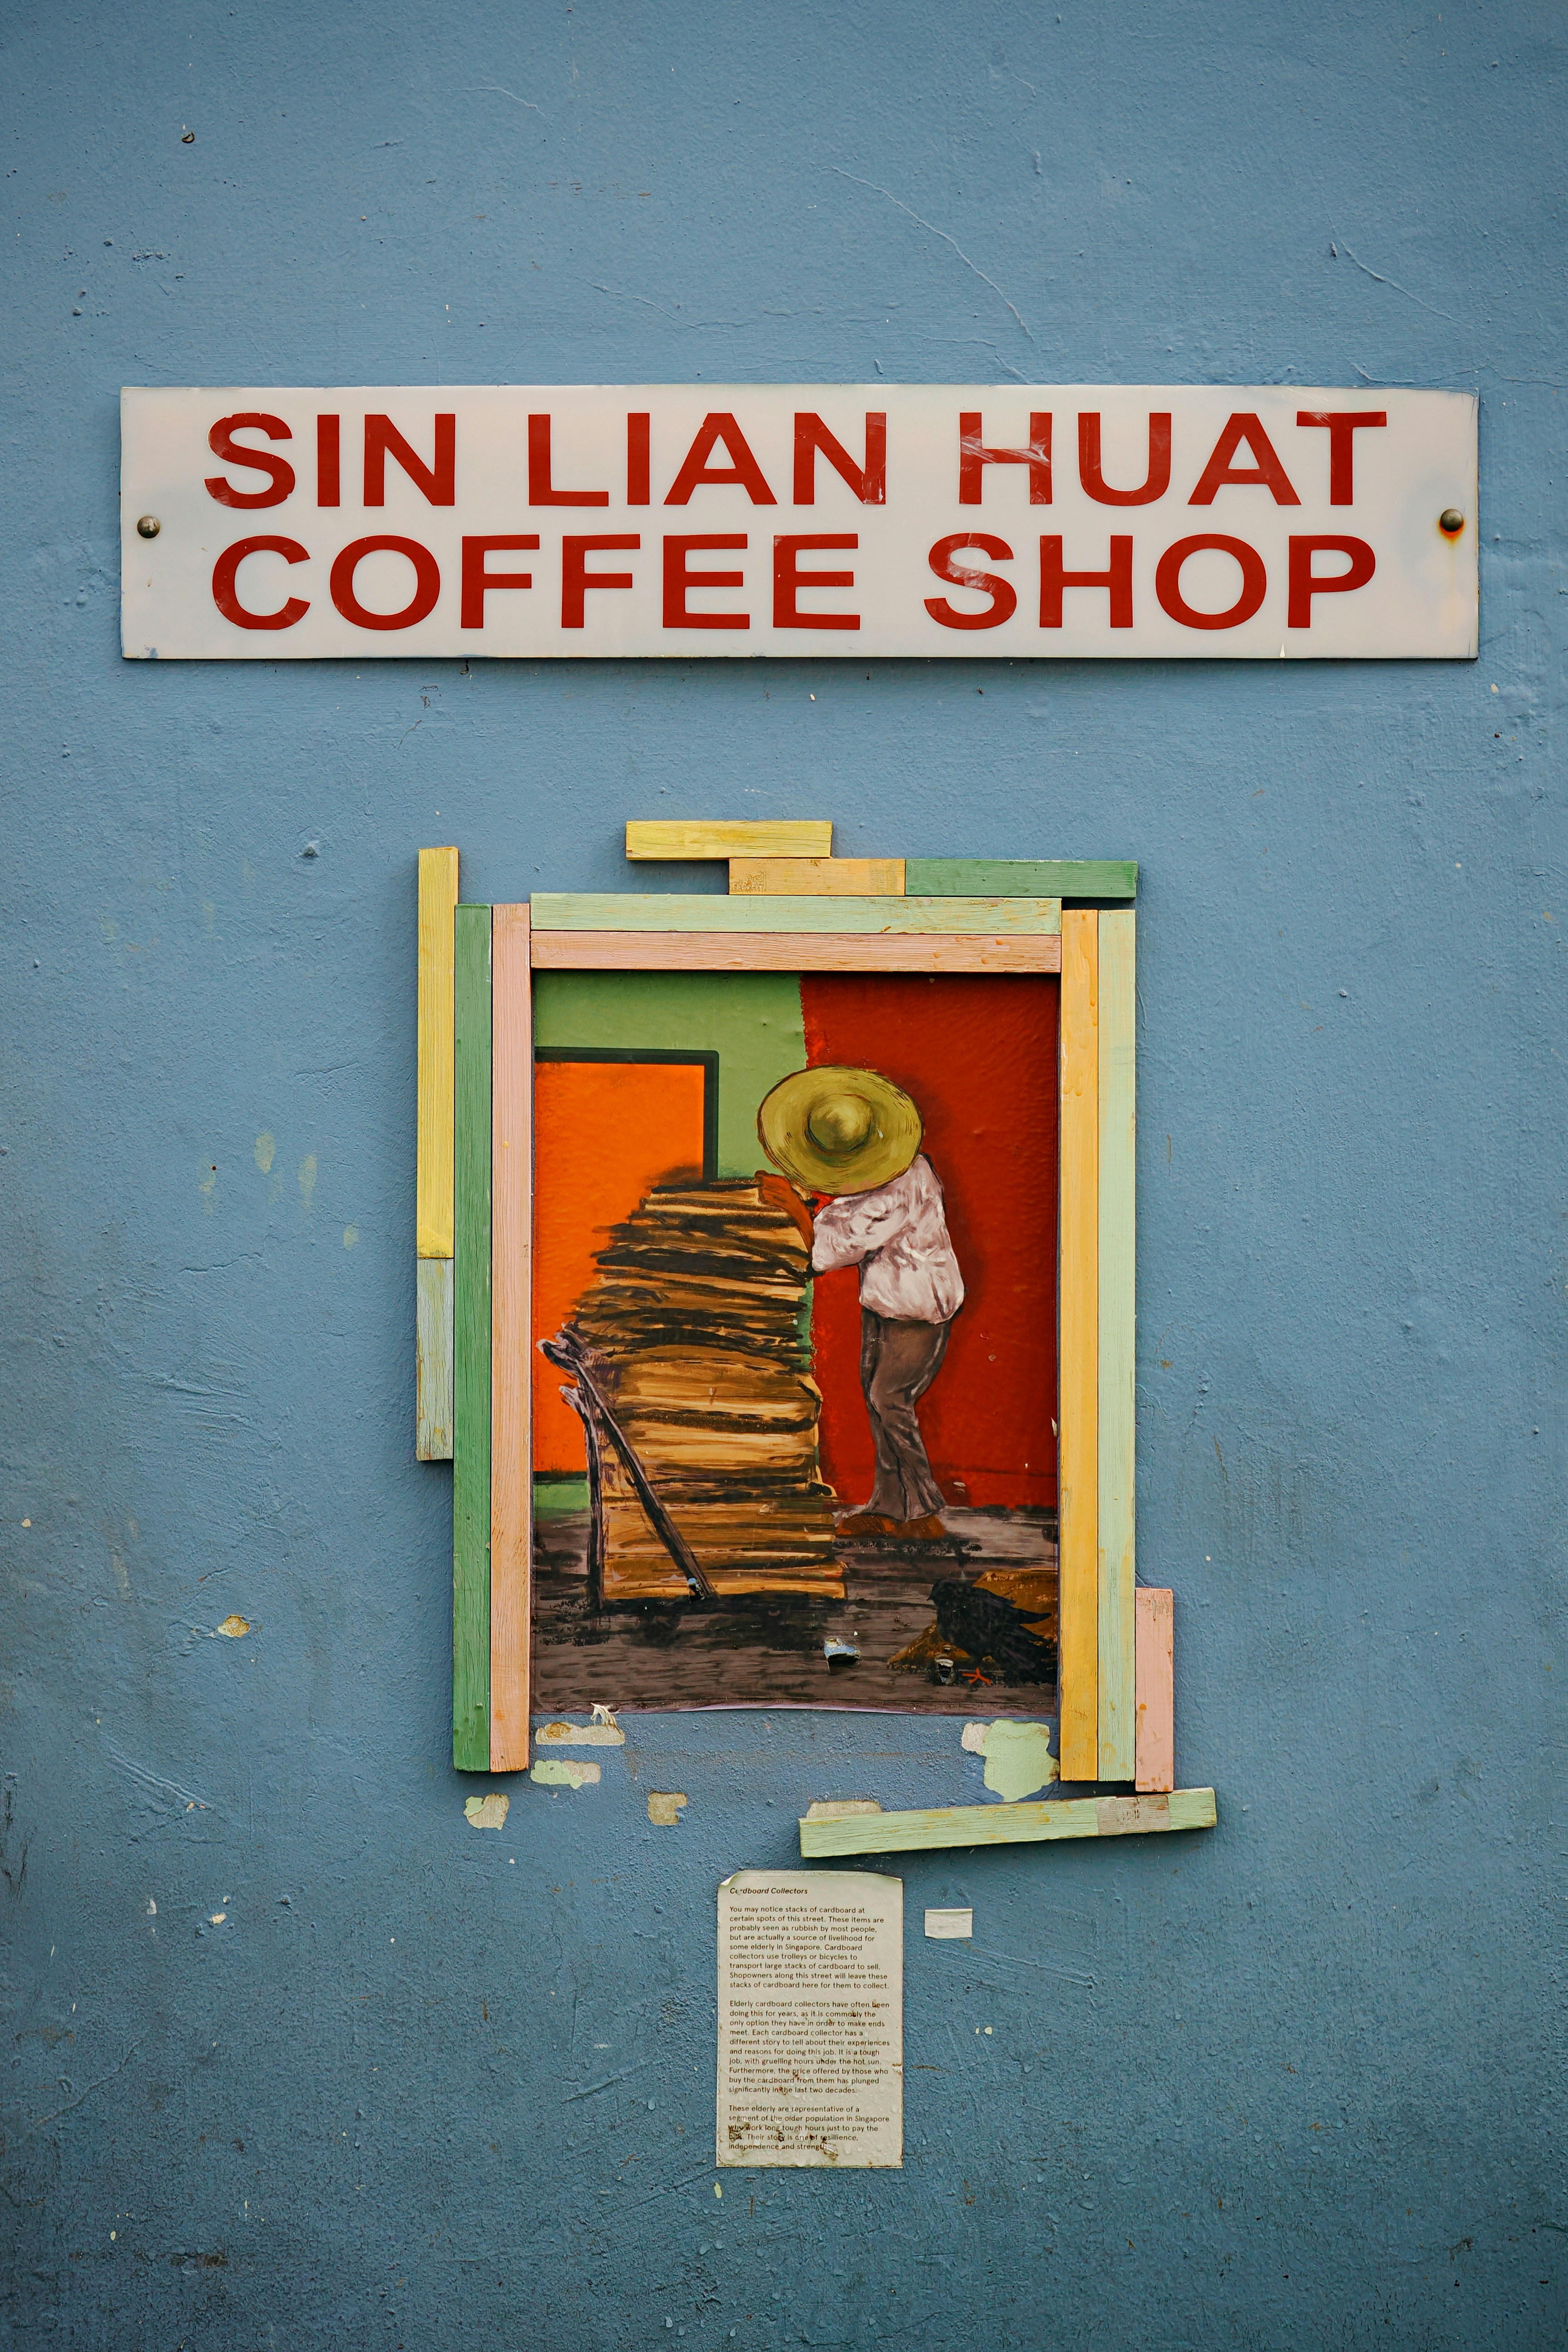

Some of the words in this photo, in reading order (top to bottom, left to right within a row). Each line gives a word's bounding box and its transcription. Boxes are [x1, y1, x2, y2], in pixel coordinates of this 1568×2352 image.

[204, 412, 456, 509] SIN
[528, 412, 887, 507] LIAN
[959, 411, 1387, 506] HUAT
[212, 533, 861, 631] COFFEE
[923, 533, 1376, 630] SHOP
[756, 1915, 776, 1923] spots
[730, 1924, 761, 1933] probably
[820, 1925, 829, 1933] by
[851, 1926, 877, 1934] people,
[757, 1934, 784, 1942] actually
[750, 1943, 775, 1952] elderly
[785, 1943, 822, 1952] Singapore.
[781, 1953, 808, 1961] trolleys
[819, 1953, 848, 1962] bicycles
[730, 1962, 763, 1970] transport
[764, 1962, 782, 1971] large
[730, 1971, 773, 1980] Shopowners
[774, 1972, 794, 1980] along
[730, 2000, 754, 2009] Elderly
[850, 2001, 870, 2009] often
[730, 2009, 749, 2019] doing
[765, 2009, 776, 2018] for
[864, 2009, 876, 2018] the
[730, 2019, 745, 2028] only
[746, 2019, 769, 2028] option
[771, 2019, 787, 2028] they
[816, 2019, 836, 2027] order
[837, 2019, 845, 2027] to
[848, 2019, 866, 2027] make
[868, 2019, 885, 2027] ends
[810, 2029, 843, 2037] collector
[730, 2037, 760, 2045] different
[762, 2038, 780, 2047] story
[847, 2039, 890, 2048] experiences
[786, 2048, 806, 2057] doing
[822, 2048, 836, 2057] job.
[859, 2048, 880, 2057] tough
[729, 2057, 742, 2066] job,
[744, 2056, 760, 2065] with
[762, 2058, 792, 2066] gruelling
[816, 2057, 837, 2066] under
[838, 2057, 852, 2065] the
[729, 2067, 776, 2075] Furthermore,
[792, 2067, 811, 2077] price
[813, 2066, 839, 2075] offered
[842, 2068, 850, 2076] by
[852, 2067, 872, 2075] those
[729, 2076, 742, 2085] buy
[757, 2075, 794, 2084] cardboard
[797, 2076, 814, 2084] from
[851, 2077, 879, 2086] plunged
[728, 2085, 771, 2095] significantly
[809, 2085, 823, 2093] two
[825, 2085, 857, 2094] decades.
[751, 2104, 776, 2114] elderly
[791, 2106, 844, 2114] representative
[729, 2115, 759, 2123] segment
[805, 2115, 844, 2123] population
[854, 2115, 890, 2125] Singapore
[764, 2123, 780, 2133] long
[782, 2123, 803, 2133] tough
[827, 2124, 840, 2133] just
[746, 2132, 765, 2141] Their
[729, 2143, 779, 2151] independence
